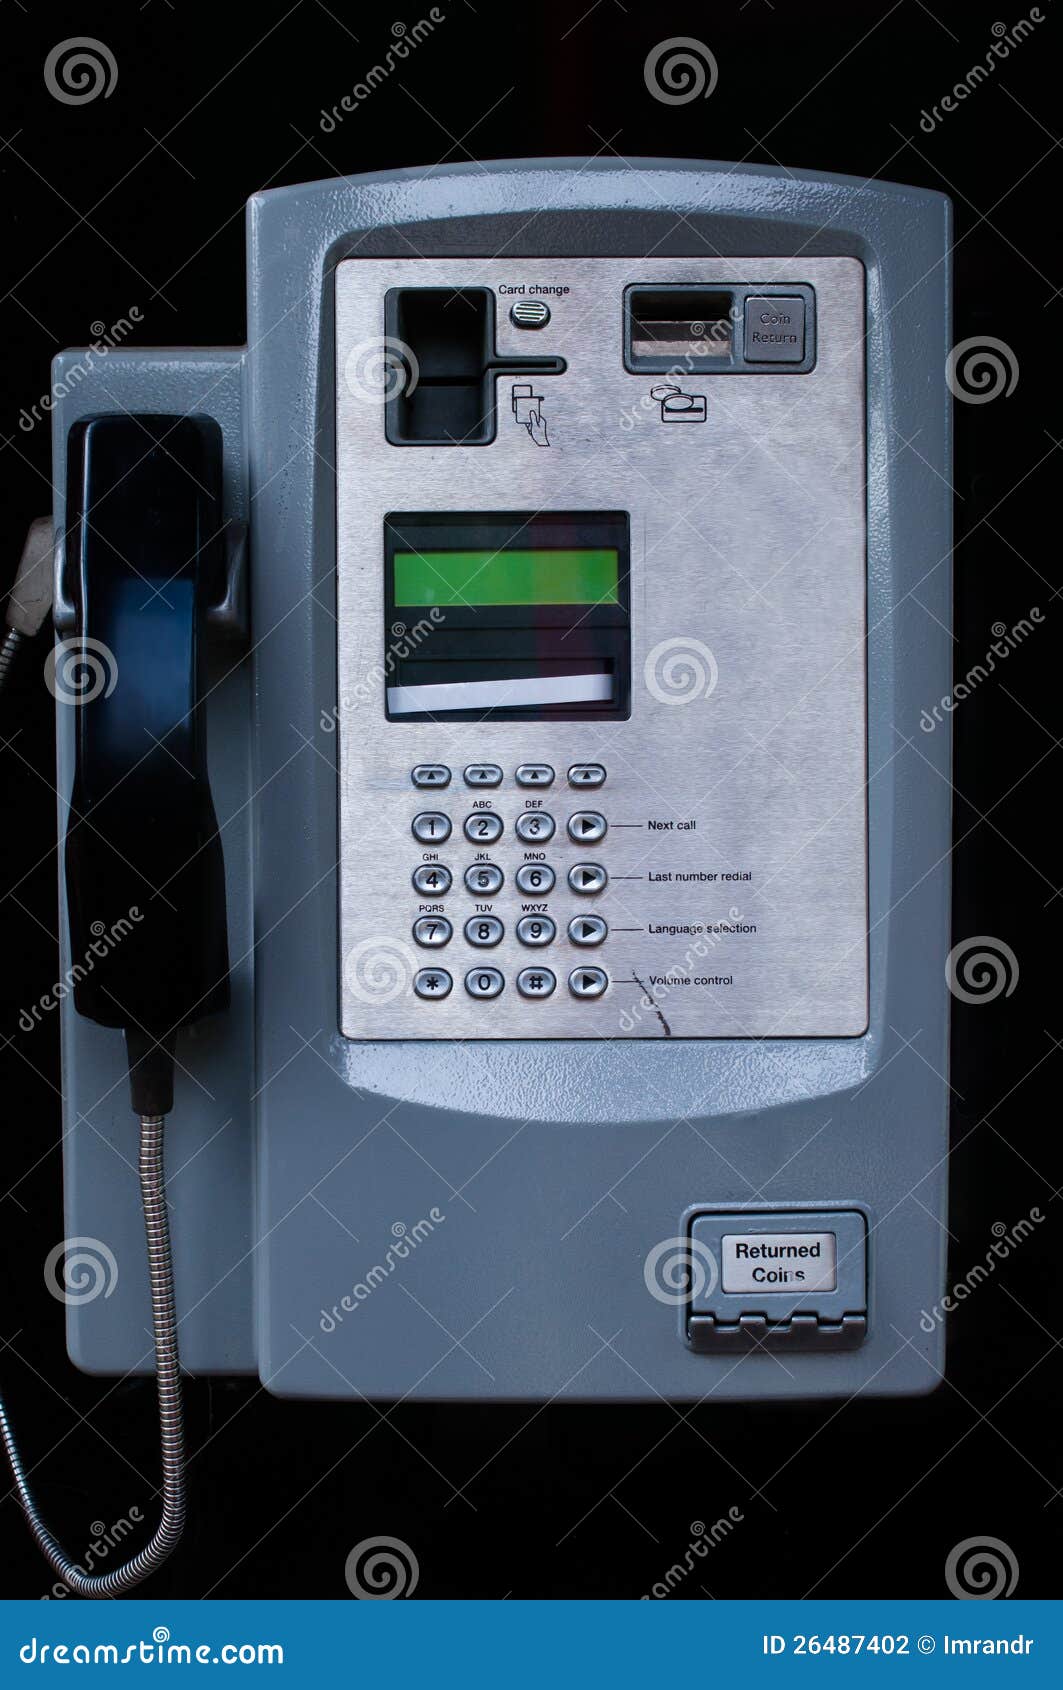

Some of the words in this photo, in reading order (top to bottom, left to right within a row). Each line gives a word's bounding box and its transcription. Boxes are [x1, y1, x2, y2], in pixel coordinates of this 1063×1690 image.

[498, 284, 526, 295] Card
[528, 284, 570, 296] change
[760, 312, 791, 325] Coin
[752, 331, 797, 343] Return
[472, 800, 492, 809] ABC
[525, 800, 543, 809] DEF
[428, 819, 436, 836] 1
[477, 820, 489, 837] 2
[528, 818, 540, 836] 3
[648, 820, 673, 830] Next
[677, 820, 696, 830] call
[422, 853, 439, 862] GHI
[474, 853, 491, 862] JKL
[524, 852, 546, 861] MNO
[425, 872, 439, 889] 4
[477, 871, 490, 888] 5
[530, 870, 542, 887] 6
[648, 872, 671, 882] Last
[675, 872, 718, 882] number
[721, 872, 752, 881] redial
[419, 904, 445, 913] PQRS
[475, 904, 493, 913] TUV
[521, 904, 549, 913] WXYZ
[427, 924, 439, 941] 7
[477, 923, 491, 941] 8
[530, 922, 543, 939] 9
[648, 924, 703, 936] Language
[706, 924, 757, 934] selection
[477, 974, 491, 991] 0
[649, 976, 691, 985] Volume
[694, 976, 733, 985] control
[736, 1242, 820, 1259] Returned
